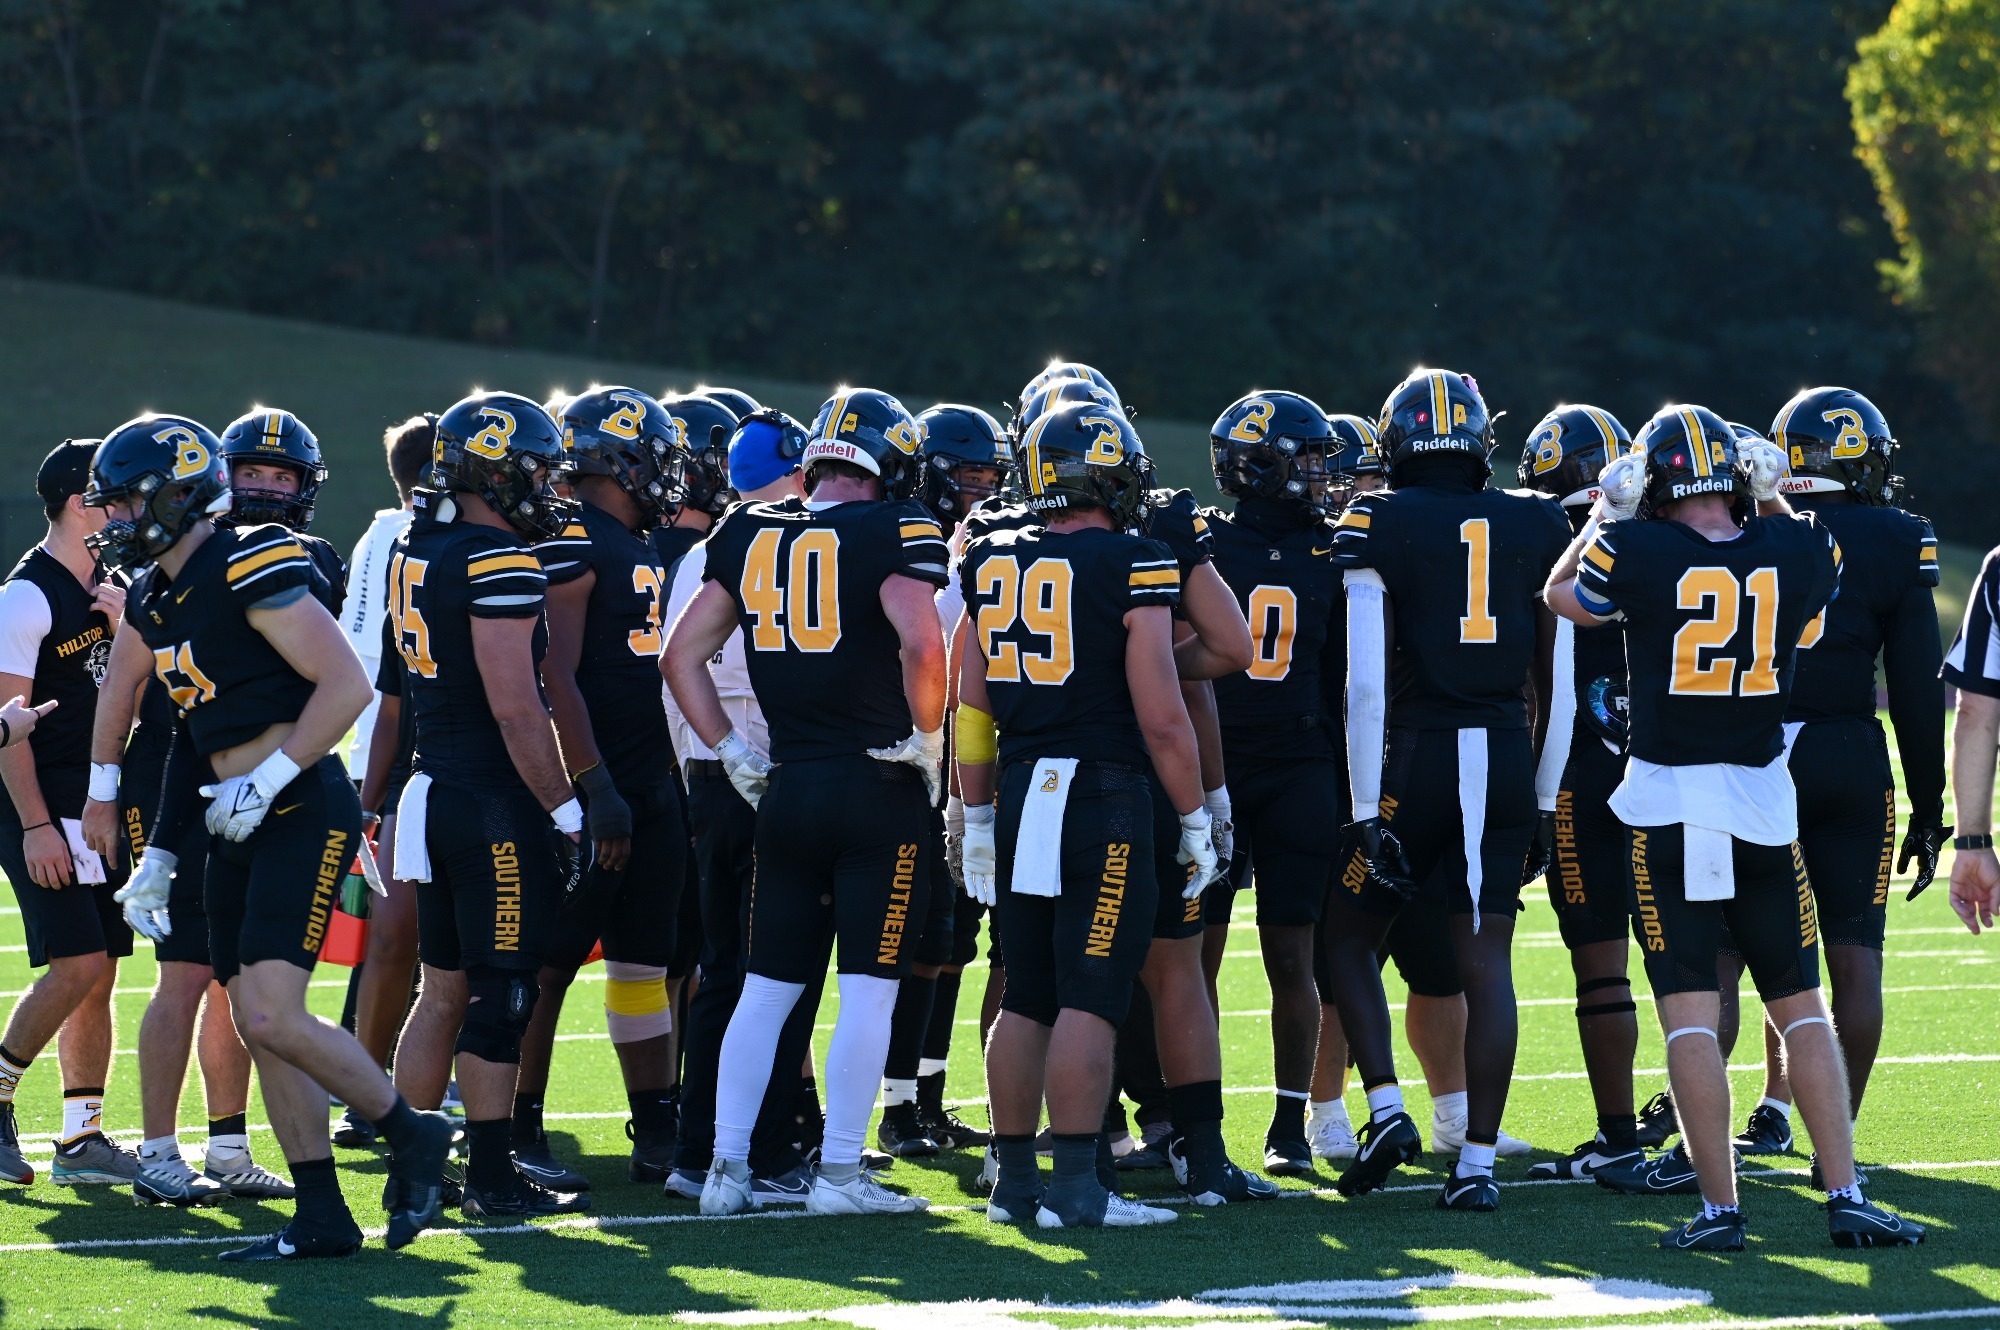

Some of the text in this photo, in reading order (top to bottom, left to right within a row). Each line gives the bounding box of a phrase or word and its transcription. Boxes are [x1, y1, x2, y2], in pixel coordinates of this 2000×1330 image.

[151, 425, 211, 481] B
[464, 406, 517, 460] B
[806, 442, 857, 460] Riddell
[842, 419, 855, 427] 40
[1079, 416, 1124, 467] B
[1412, 436, 1470, 453] Riddell
[1822, 407, 1868, 460] B
[1024, 494, 1068, 511] Riddell
[1671, 478, 1733, 499] Riddell
[388, 551, 438, 679] 45
[628, 564, 665, 657] 3
[740, 527, 843, 653] 40
[976, 554, 1075, 687] 29
[1245, 584, 1298, 682] 0
[1459, 518, 1497, 643] 1
[1668, 566, 1780, 698] 21
[55, 626, 103, 658] HILLTOP
[303, 829, 348, 954] SOUTHERN
[491, 841, 520, 951] SOUTHERN
[1085, 843, 1131, 958] SOUTHERN
[1556, 790, 1586, 904] SOUTHERN
[1631, 829, 1666, 953] SOUTHERN
[1790, 840, 1818, 949] OUTHERN
[1872, 788, 1895, 905] SOUTHERN
[877, 843, 918, 965] SOUTHERN
